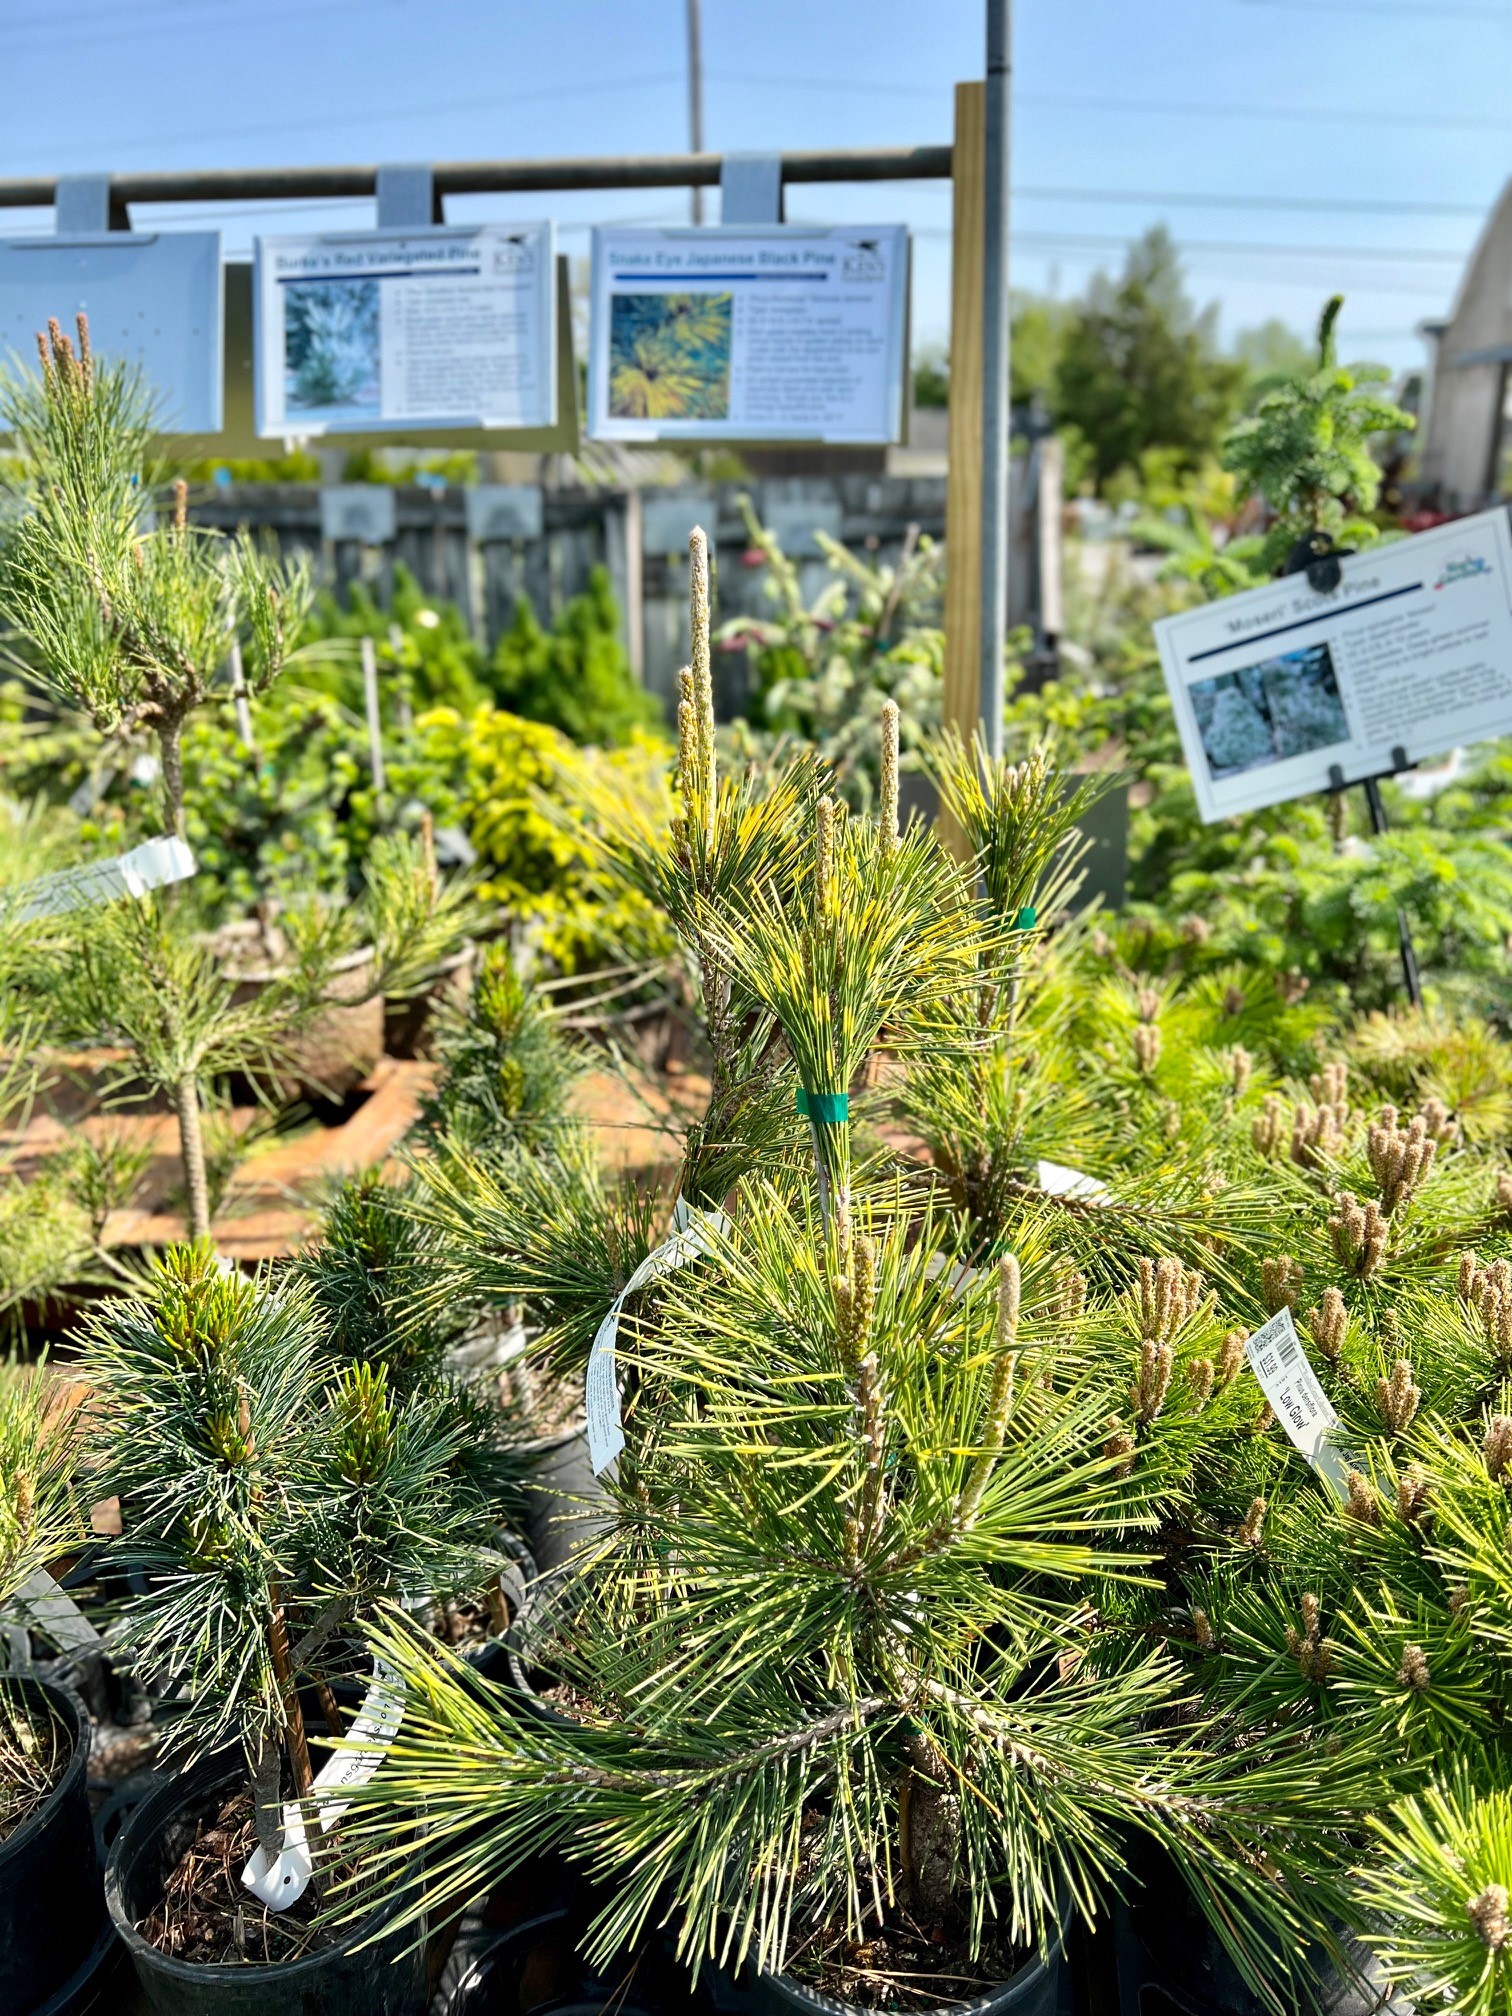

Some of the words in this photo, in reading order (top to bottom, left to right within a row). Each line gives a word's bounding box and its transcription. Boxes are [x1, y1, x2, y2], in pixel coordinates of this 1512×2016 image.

[443, 247, 482, 263] Pine
[609, 251, 652, 267] Snake
[655, 250, 683, 268] Eye
[686, 250, 754, 268] Japanese
[757, 250, 799, 266] Black
[802, 249, 837, 266] Pine
[1301, 1391, 1318, 1418] densiflora
